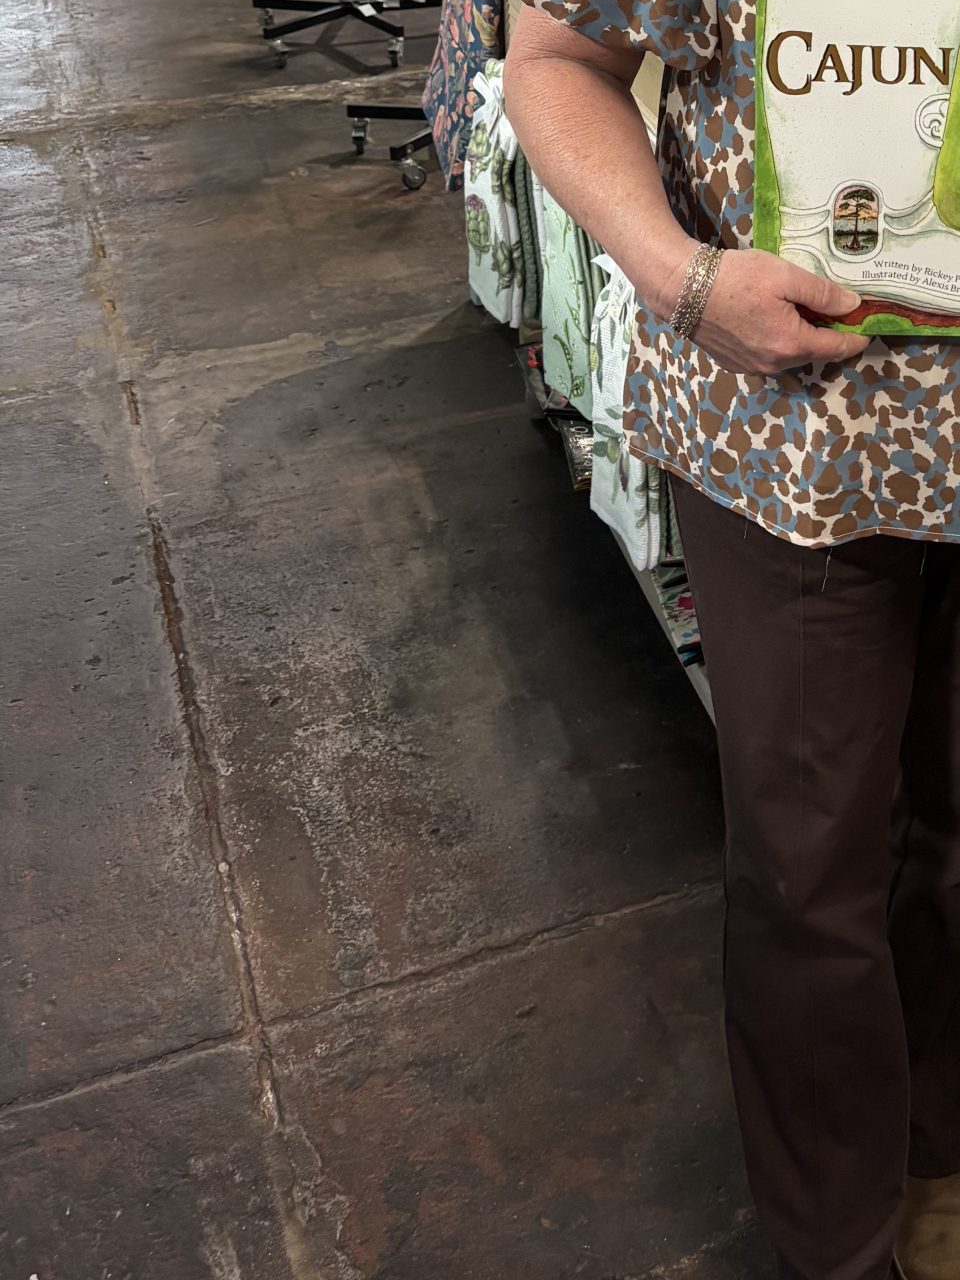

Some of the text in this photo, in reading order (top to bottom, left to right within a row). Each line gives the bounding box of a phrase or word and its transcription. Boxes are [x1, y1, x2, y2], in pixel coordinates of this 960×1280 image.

[766, 30, 955, 97] CAJUN
[862, 270, 908, 280] Illustrated
[910, 274, 922, 285] by
[922, 278, 949, 290] Alexis
[873, 260, 910, 271] Written
[911, 263, 924, 275] by
[924, 267, 954, 283] Rickey
